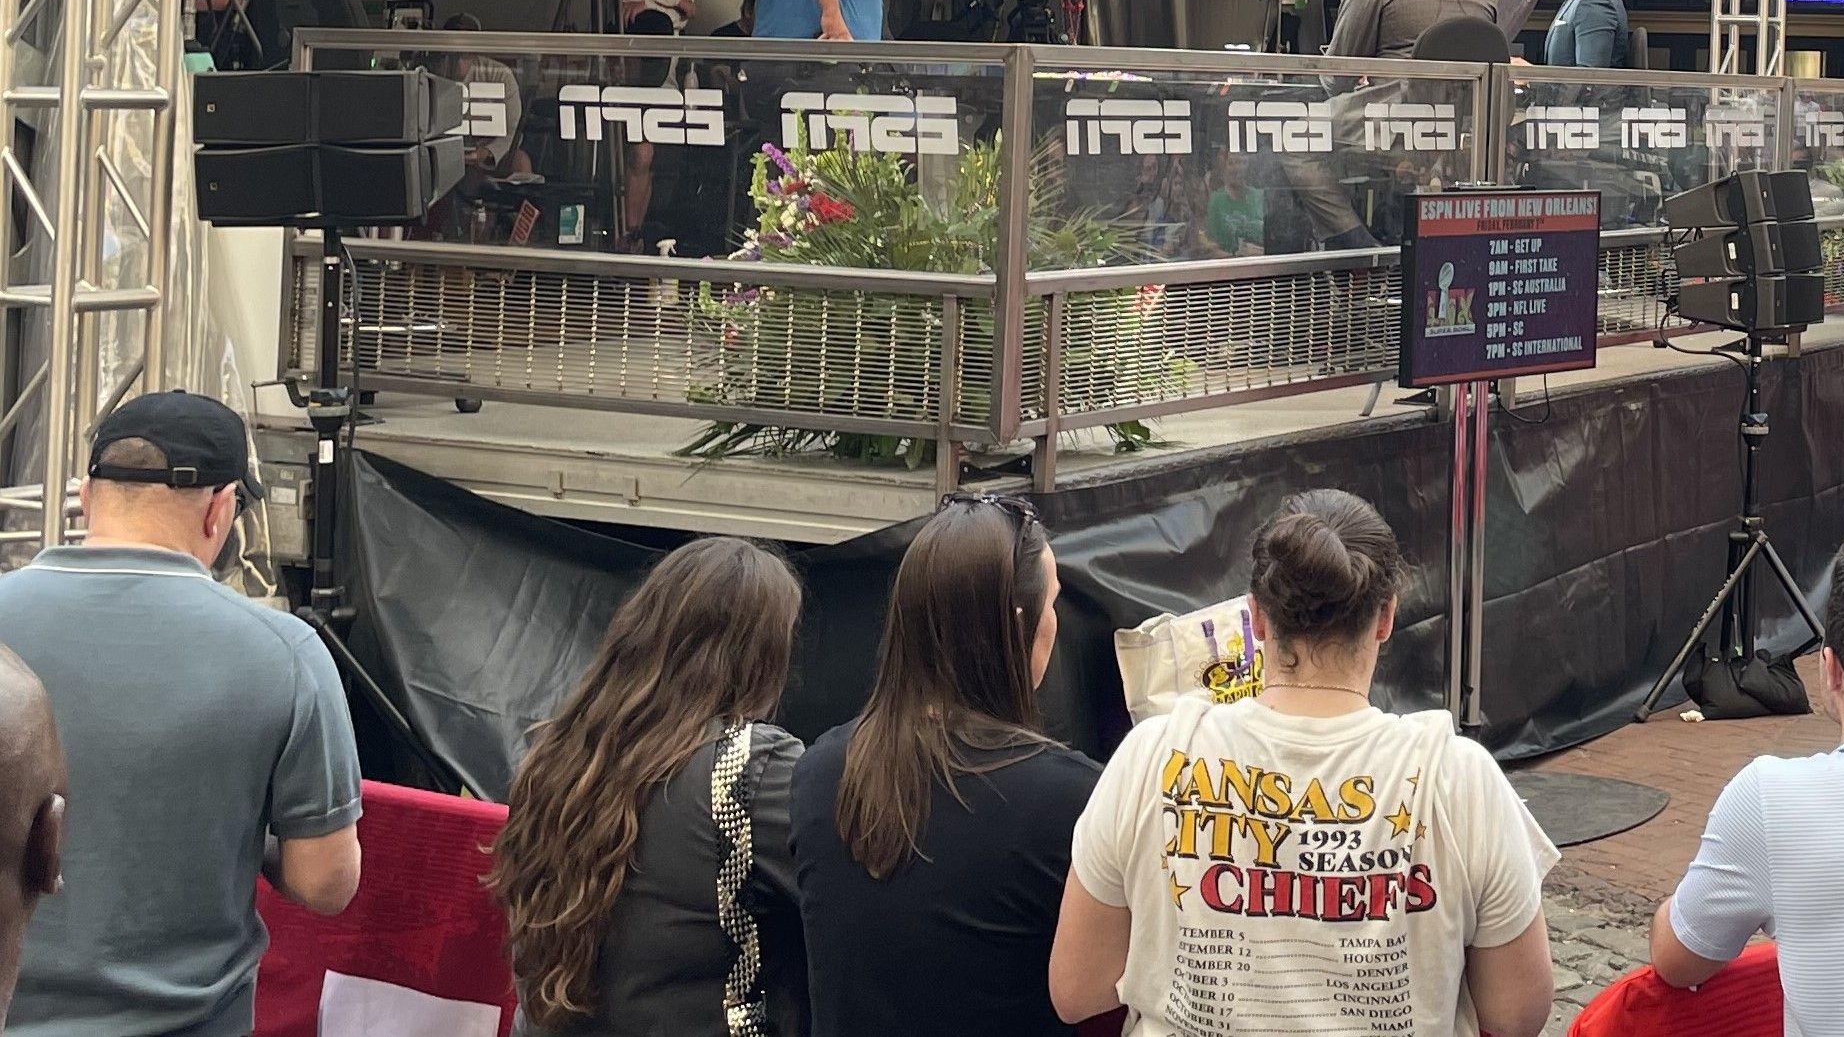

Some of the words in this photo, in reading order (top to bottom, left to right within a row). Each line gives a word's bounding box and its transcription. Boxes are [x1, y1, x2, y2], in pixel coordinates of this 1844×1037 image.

[1421, 200, 1453, 220] ESPN
[1455, 199, 1482, 219] LIVE
[1483, 198, 1516, 218] FROM
[1518, 198, 1543, 217] NEW
[1489, 240, 1508, 255] 7AM
[1515, 239, 1529, 254] GET
[1531, 238, 1542, 253] UP
[1515, 258, 1537, 274] FIRST
[1539, 258, 1558, 272] TAKE
[1488, 281, 1506, 296] 1PM
[1512, 279, 1524, 295] SC
[1524, 277, 1567, 294] AUSTRALIA
[1487, 302, 1507, 317] 3PM
[1513, 300, 1528, 315] NFL
[1529, 299, 1546, 314] LIVE
[1512, 321, 1524, 336] SC
[1486, 343, 1505, 360] 7PM
[1512, 342, 1523, 357] SC
[1524, 336, 1583, 356] INTERNATIONAL
[1298, 830, 1362, 850] 1993
[1298, 843, 1413, 873] SEASON
[1200, 863, 1437, 922] CHIEFS
[1339, 937, 1382, 949] TAMPA
[1386, 933, 1407, 948] BAY
[1238, 947, 1252, 958] 12
[1343, 948, 1408, 964] HOUSTON
[1236, 962, 1251, 972] 20
[1356, 962, 1409, 978] DENVER
[1222, 977, 1229, 987] 3
[1326, 978, 1350, 989] LOS
[1352, 976, 1410, 992] ANGELES
[1221, 992, 1235, 1002] 10
[1333, 989, 1411, 1005] CINCINNATI
[1169, 992, 1215, 1028] OCTOBER
[1218, 1020, 1231, 1031] 31
[1371, 1018, 1413, 1032] MIAMI
[1219, 1007, 1234, 1018] 17
[1340, 1006, 1365, 1017] SAN
[1369, 1004, 1412, 1018] DIEGO
